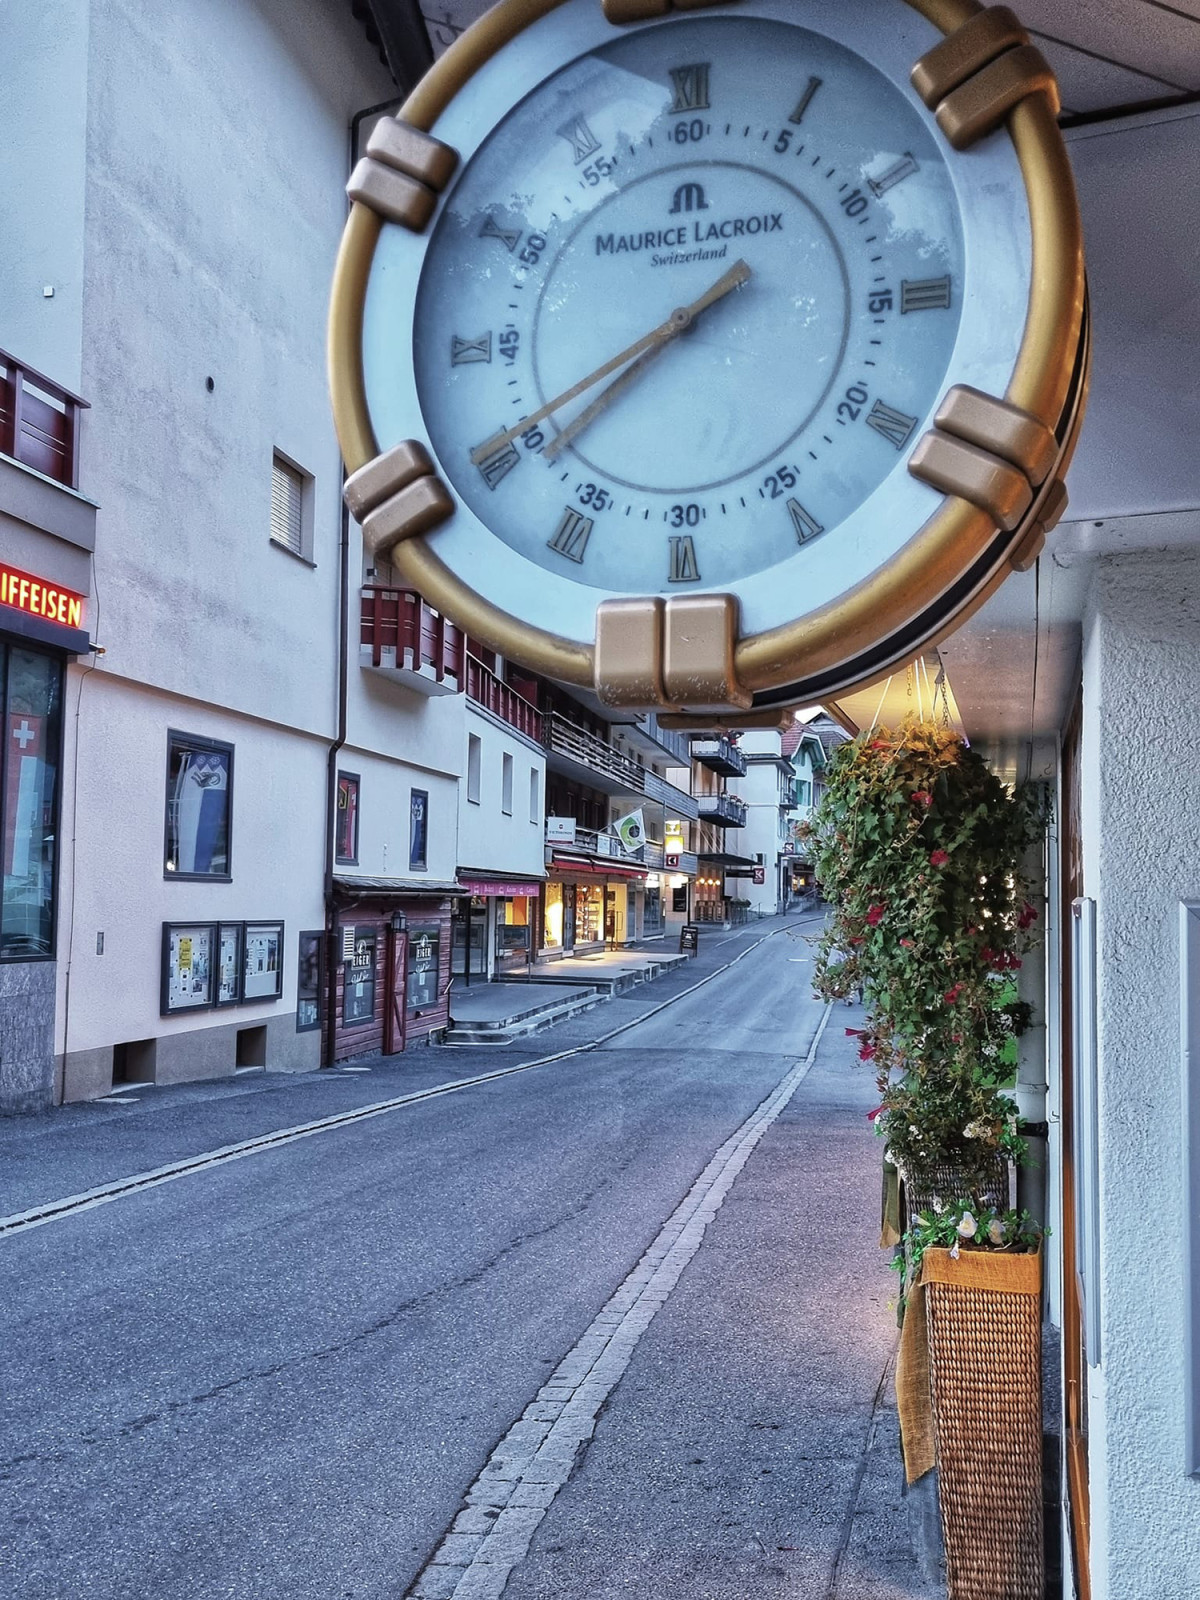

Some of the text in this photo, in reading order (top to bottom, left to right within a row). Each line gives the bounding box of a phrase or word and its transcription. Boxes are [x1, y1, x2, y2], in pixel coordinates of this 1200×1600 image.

[668, 62, 711, 114] XII
[789, 76, 823, 125] I
[556, 111, 602, 166] XI
[674, 119, 704, 145] 60
[774, 129, 793, 154] 5
[582, 156, 613, 187] 55
[840, 188, 869, 218] 10
[478, 214, 523, 252] X
[518, 234, 548, 266] 50
[595, 212, 783, 256] MAURICE LACROIX
[650, 244, 727, 267] Switzerland
[868, 288, 893, 314] 15
[901, 274, 951, 315] III
[451, 330, 493, 368] IX
[499, 330, 520, 360] 45
[837, 386, 869, 421] 20
[865, 398, 919, 451] IV
[579, 483, 611, 512] 35
[764, 465, 797, 500] 25
[670, 503, 700, 528] 30
[786, 497, 825, 546] V
[546, 504, 595, 565] VII
[668, 535, 702, 583] VI
[1, 571, 82, 628] IFFEISEN
